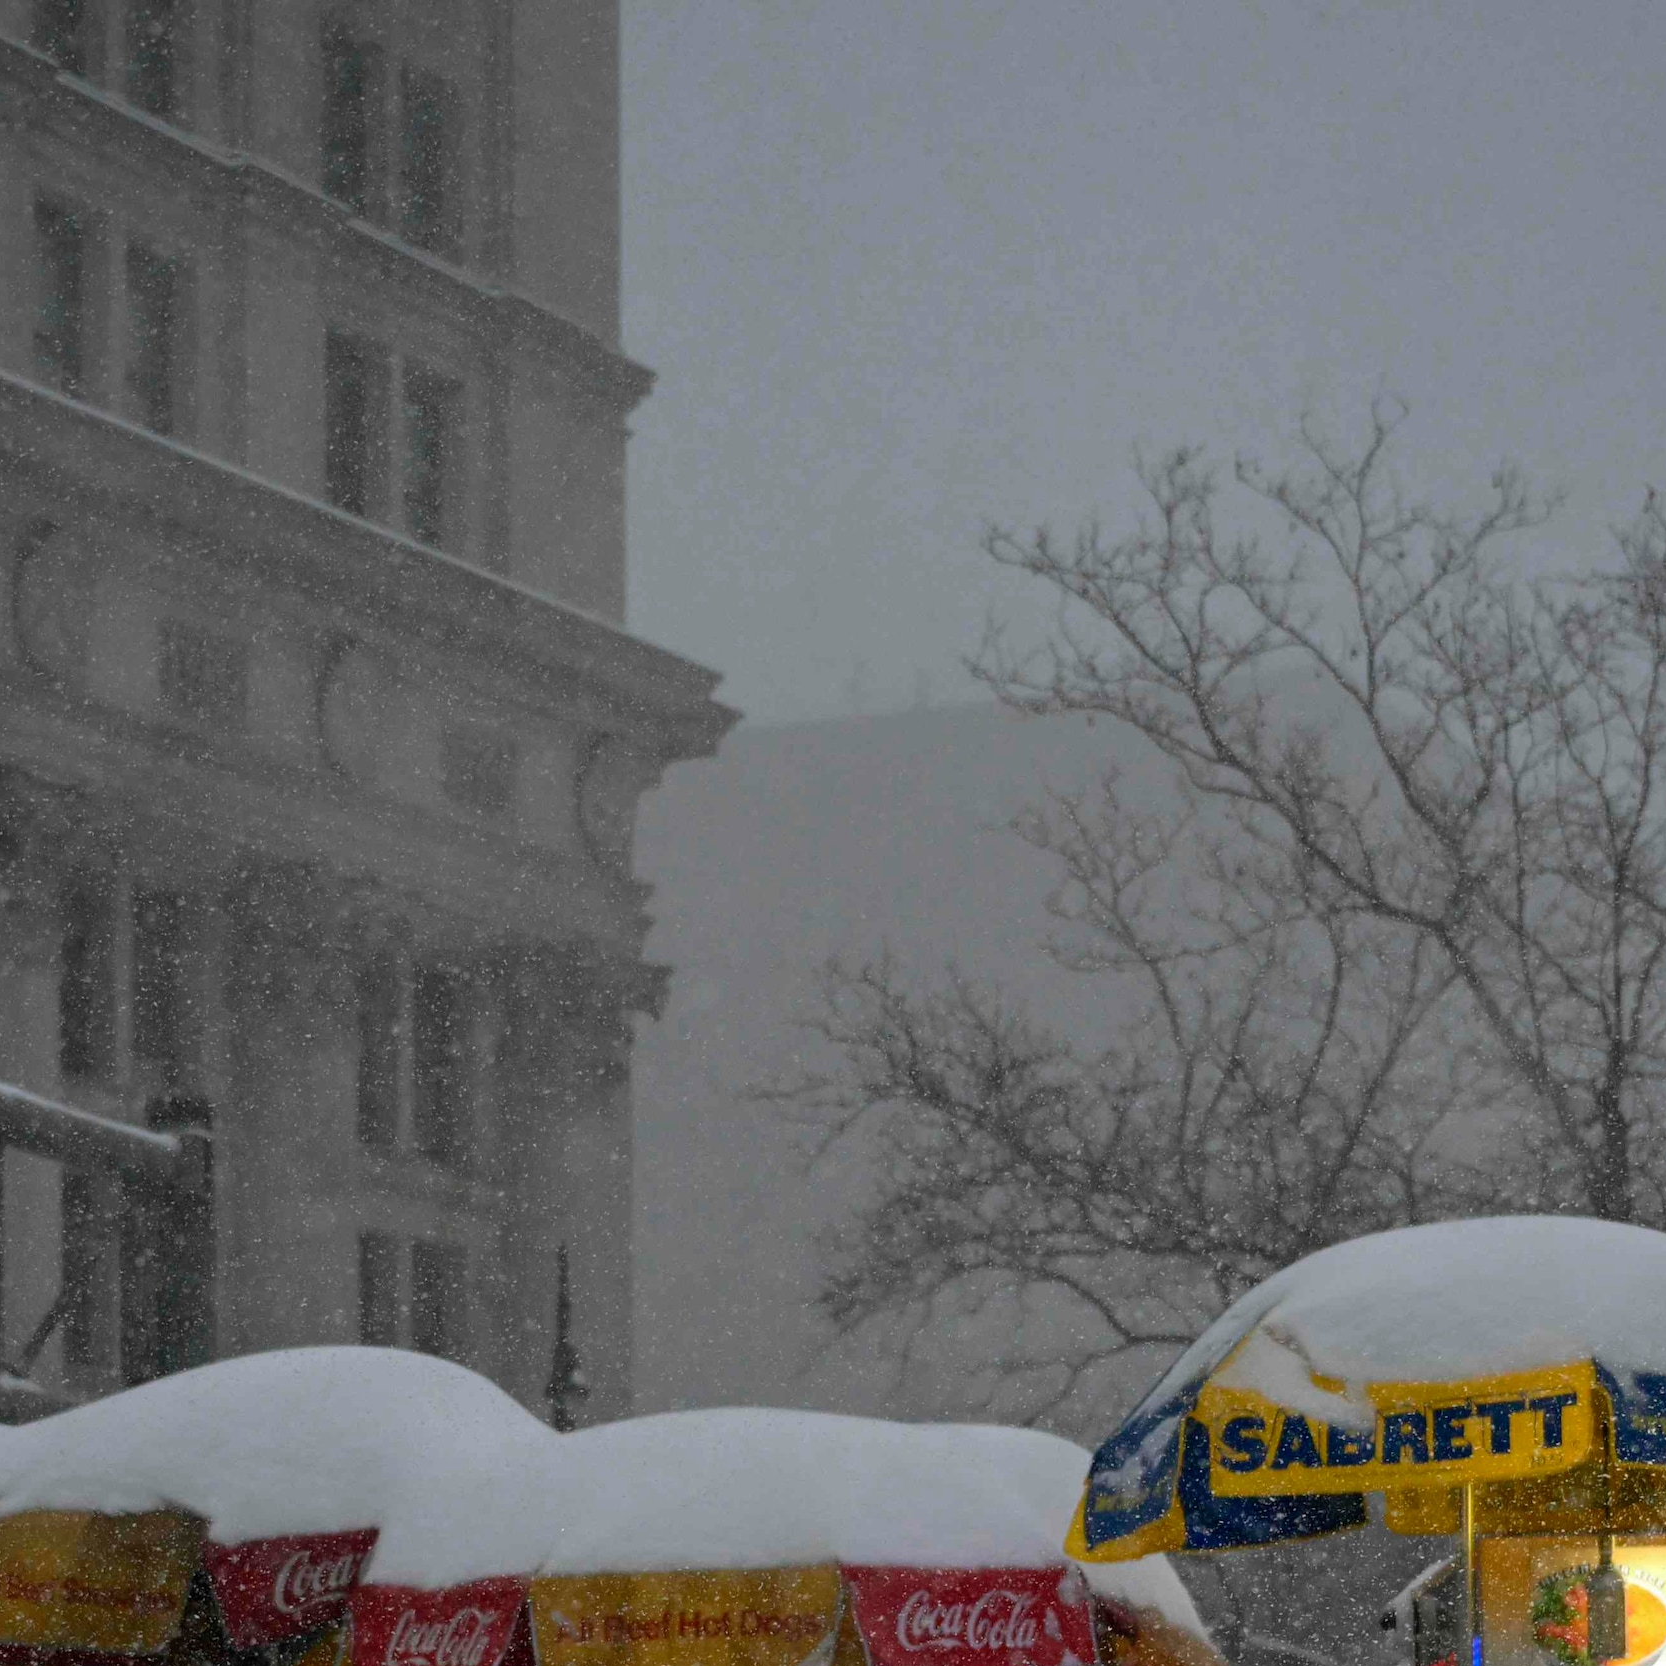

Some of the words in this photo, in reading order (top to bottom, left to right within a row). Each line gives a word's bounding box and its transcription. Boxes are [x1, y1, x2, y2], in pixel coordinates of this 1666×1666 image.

[1219, 1391, 1577, 1473] SABRETT
[679, 1610, 731, 1639] Hot
[739, 1609, 821, 1642] Dogs
[896, 1588, 1039, 1652] Coca-Cola
